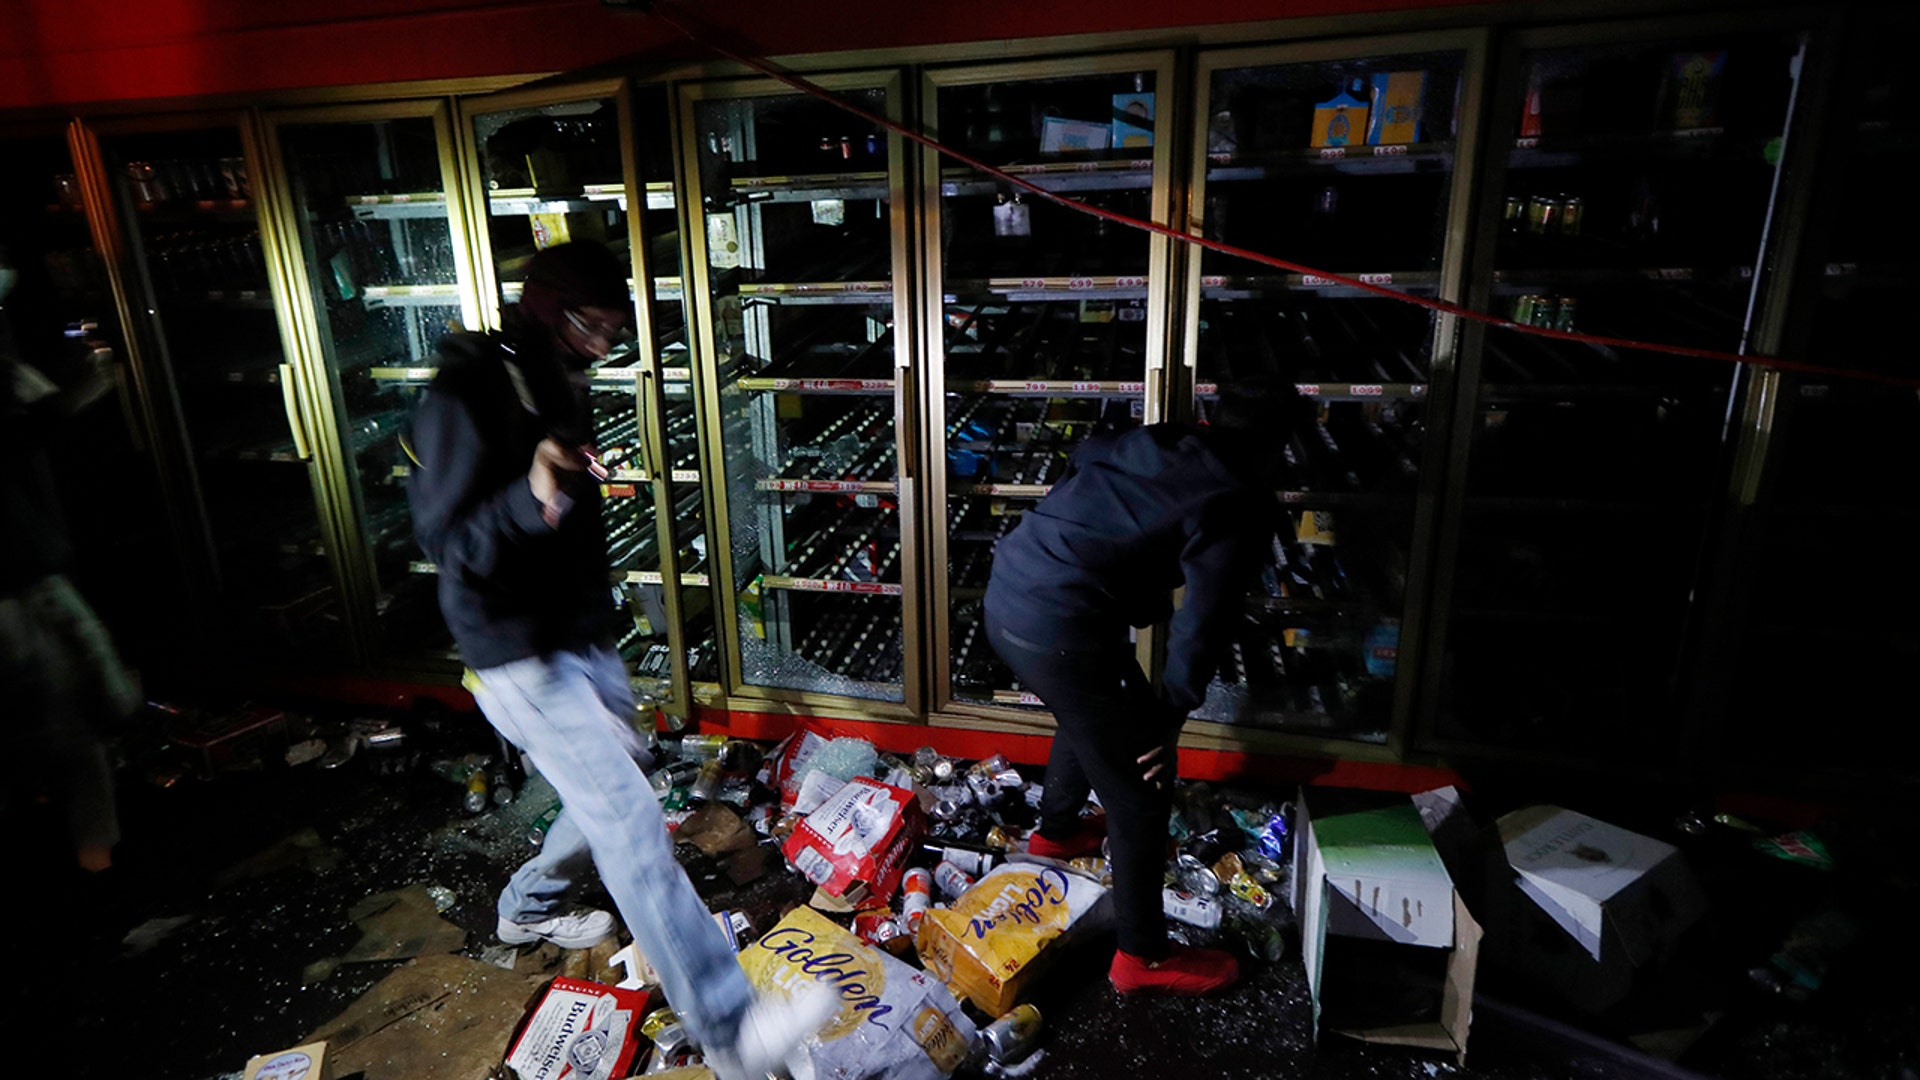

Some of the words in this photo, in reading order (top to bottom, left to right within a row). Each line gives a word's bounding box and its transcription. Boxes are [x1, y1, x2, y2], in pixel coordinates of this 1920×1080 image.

[827, 787, 871, 835] Budweiser
[553, 983, 602, 996] GENUINE
[760, 928, 893, 1031] Golden
[771, 964, 815, 1000] LIG
[910, 973, 926, 987] 24
[535, 1001, 588, 1080] Budweiser
